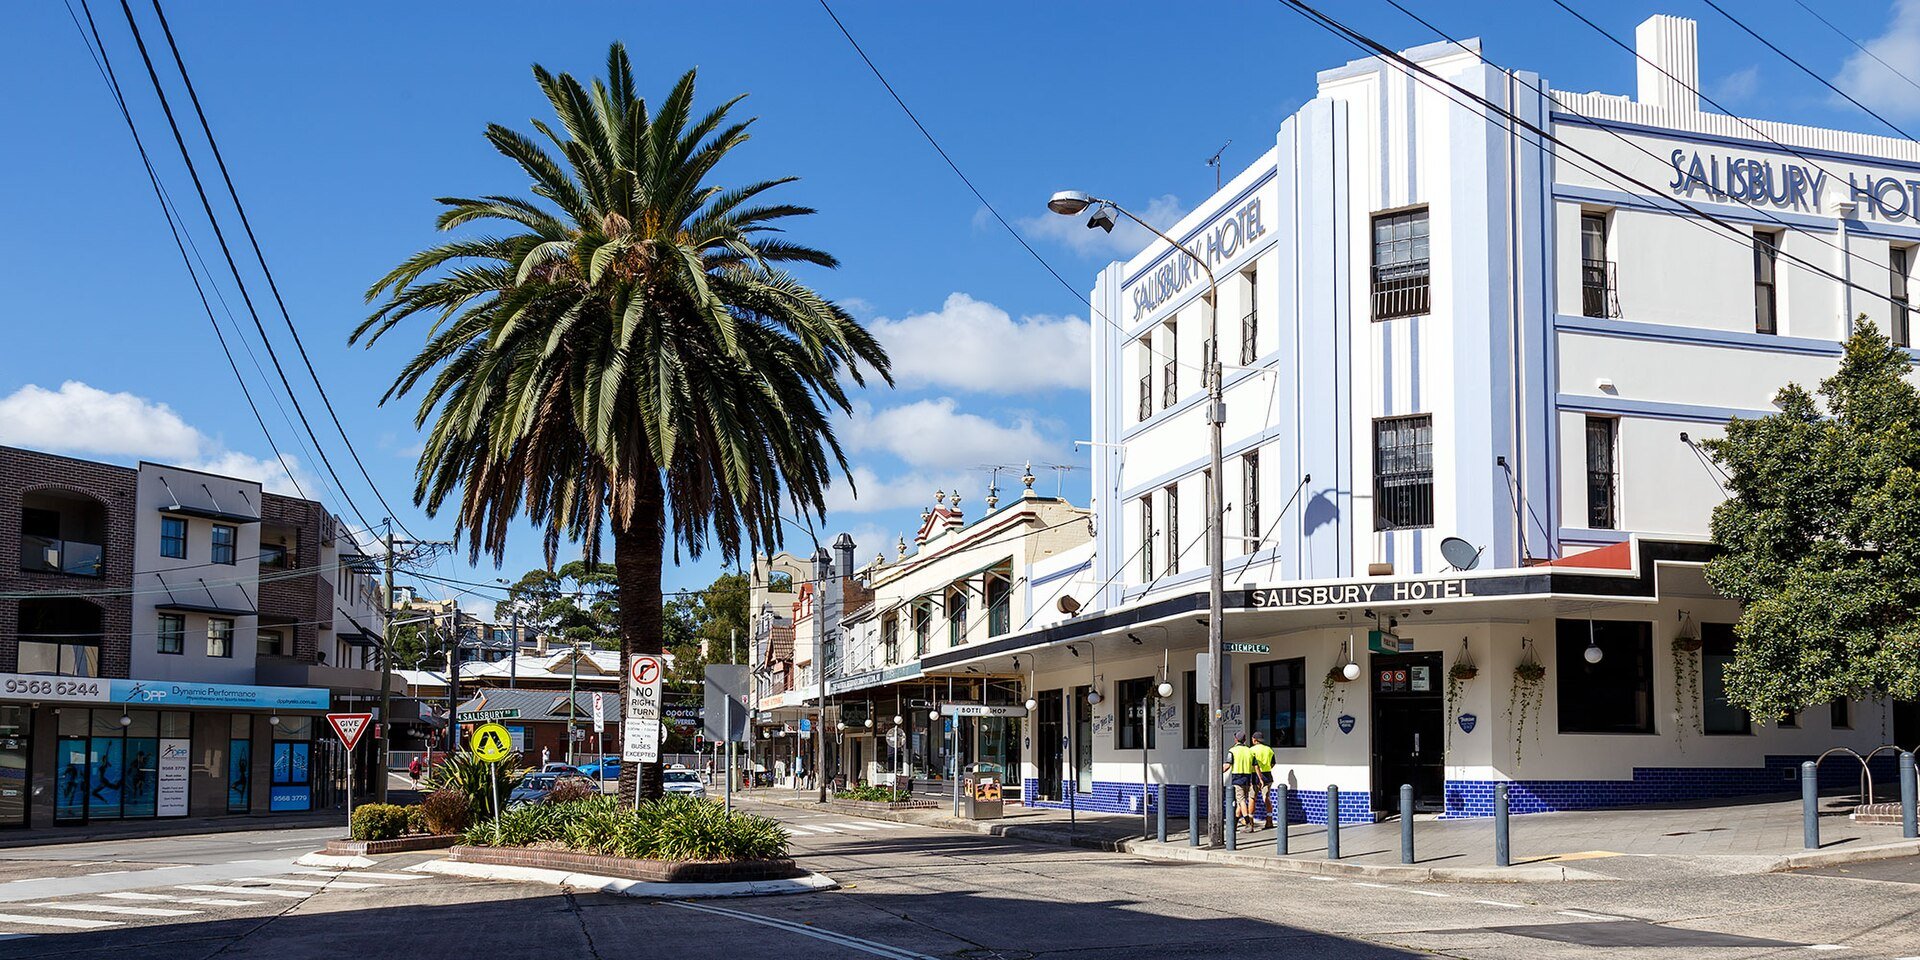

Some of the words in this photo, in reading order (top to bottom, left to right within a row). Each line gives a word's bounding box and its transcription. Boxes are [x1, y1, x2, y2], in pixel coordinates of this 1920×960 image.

[1670, 149, 1827, 213] SALISBURY
[1133, 240, 1201, 321] SALISBURY
[1206, 197, 1265, 272] HOTEL
[1252, 584, 1376, 607] SALISBURY
[1393, 579, 1474, 601] HOTEL
[1235, 643, 1260, 652] TEMPLE
[5, 679, 52, 695] 9568
[55, 682, 99, 696] 6244
[172, 685, 206, 697] Dynamic
[207, 687, 257, 698] Performance
[635, 686, 653, 697] NO
[142, 690, 167, 701] DPP
[632, 699, 655, 707] RIGHT
[463, 710, 504, 721] SALISBURY
[632, 707, 655, 716] TURN
[665, 709, 694, 718] oporto
